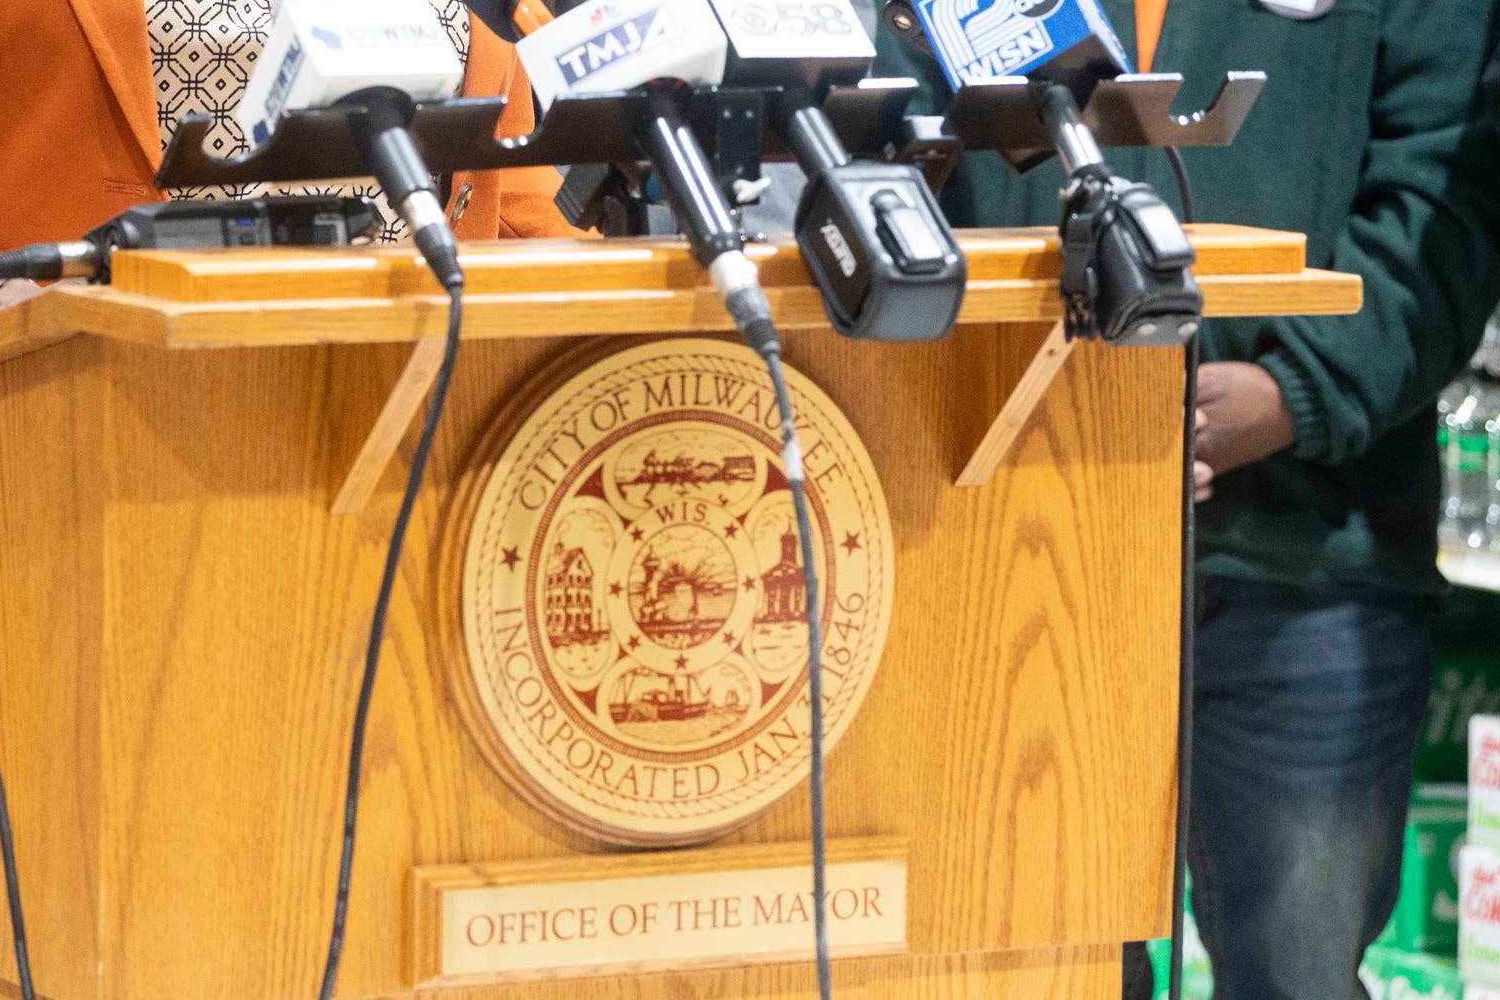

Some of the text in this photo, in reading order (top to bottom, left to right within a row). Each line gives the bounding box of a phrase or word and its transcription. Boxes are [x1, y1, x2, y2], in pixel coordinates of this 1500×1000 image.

[958, 28, 1048, 78] WISN
[519, 418, 586, 511] CITY
[590, 386, 631, 432] OF
[495, 608, 721, 799] INCORPORATED
[820, 592, 865, 681] 1846
[466, 906, 598, 947] OFFICE
[609, 902, 659, 937] OF
[669, 896, 742, 931] THE
